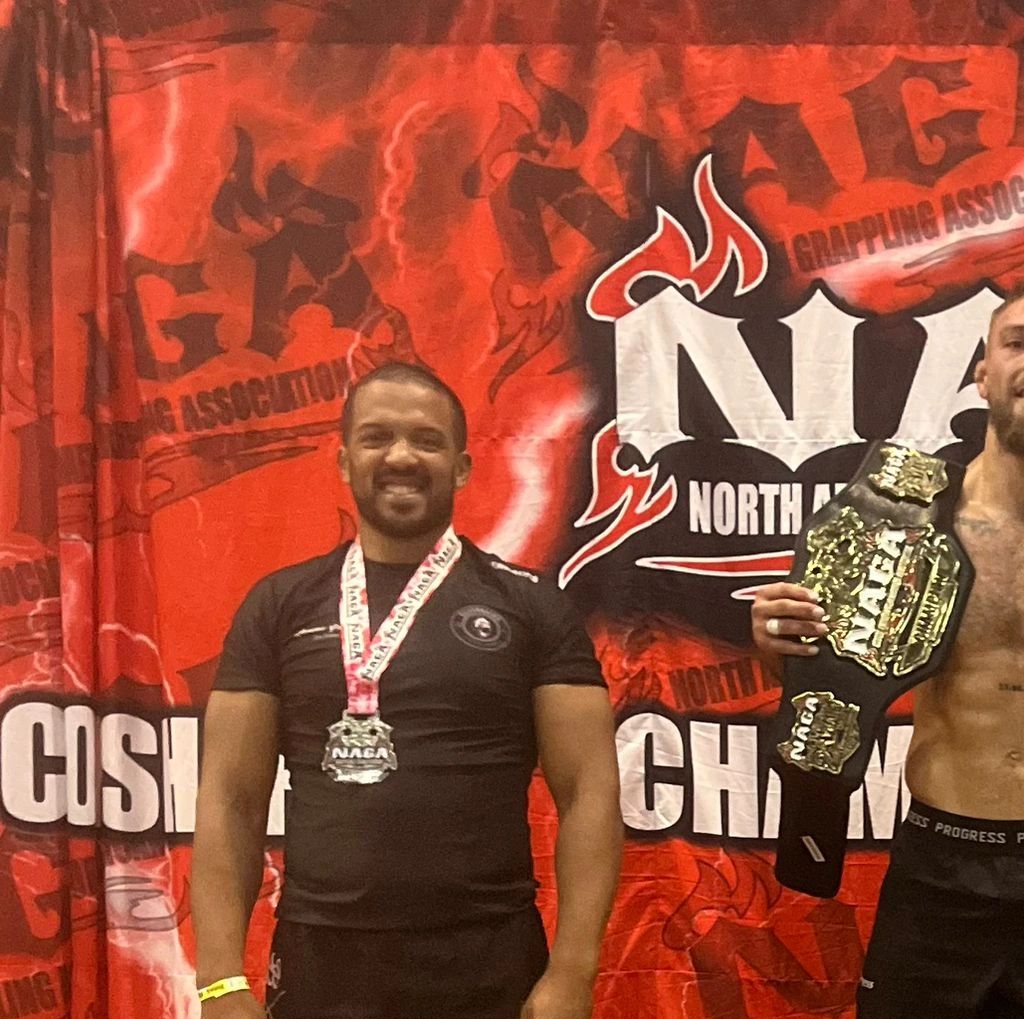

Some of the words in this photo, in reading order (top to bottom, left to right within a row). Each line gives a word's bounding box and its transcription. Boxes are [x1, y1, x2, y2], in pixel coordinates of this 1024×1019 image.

[793, 199, 942, 273] GRAPPLING
[180, 356, 350, 433] ASSOCIATION
[689, 480, 803, 536] NORTH
[842, 528, 908, 656] NAGA
[331, 747, 389, 759] NAGA
[790, 697, 819, 761] NAGA
[934, 821, 1007, 845] PROGRESS
